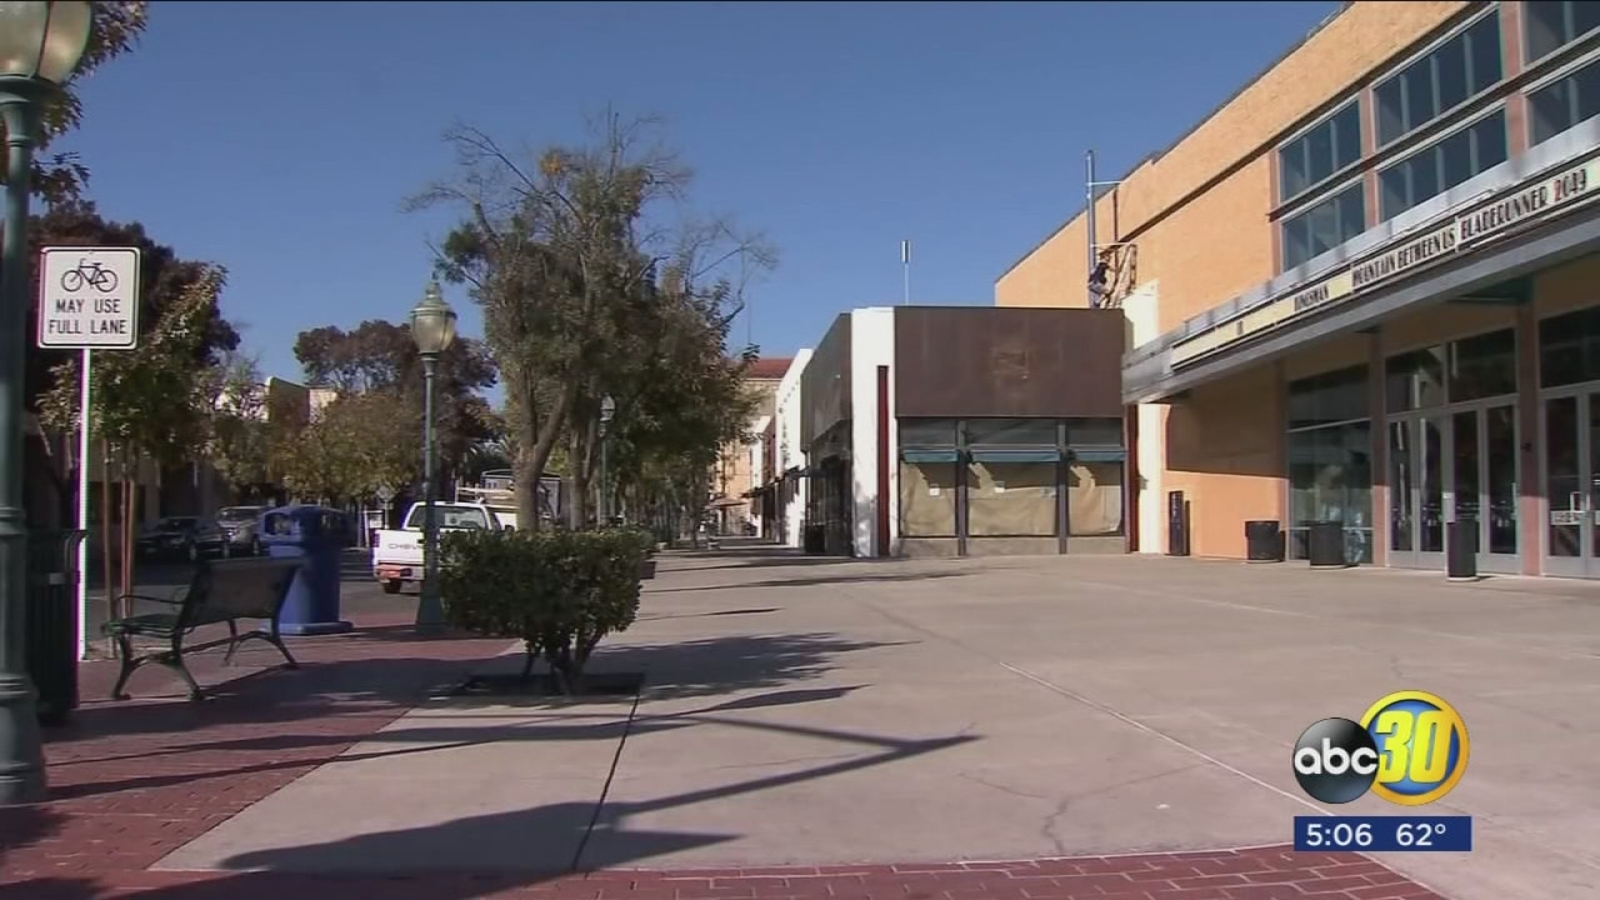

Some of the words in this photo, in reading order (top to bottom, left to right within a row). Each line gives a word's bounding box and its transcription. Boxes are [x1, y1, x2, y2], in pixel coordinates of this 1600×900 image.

[1554, 169, 1587, 200] 2049
[55, 299, 85, 313] MAY
[94, 299, 121, 313] USE
[48, 319, 83, 334] FULL
[90, 319, 127, 334] LANE
